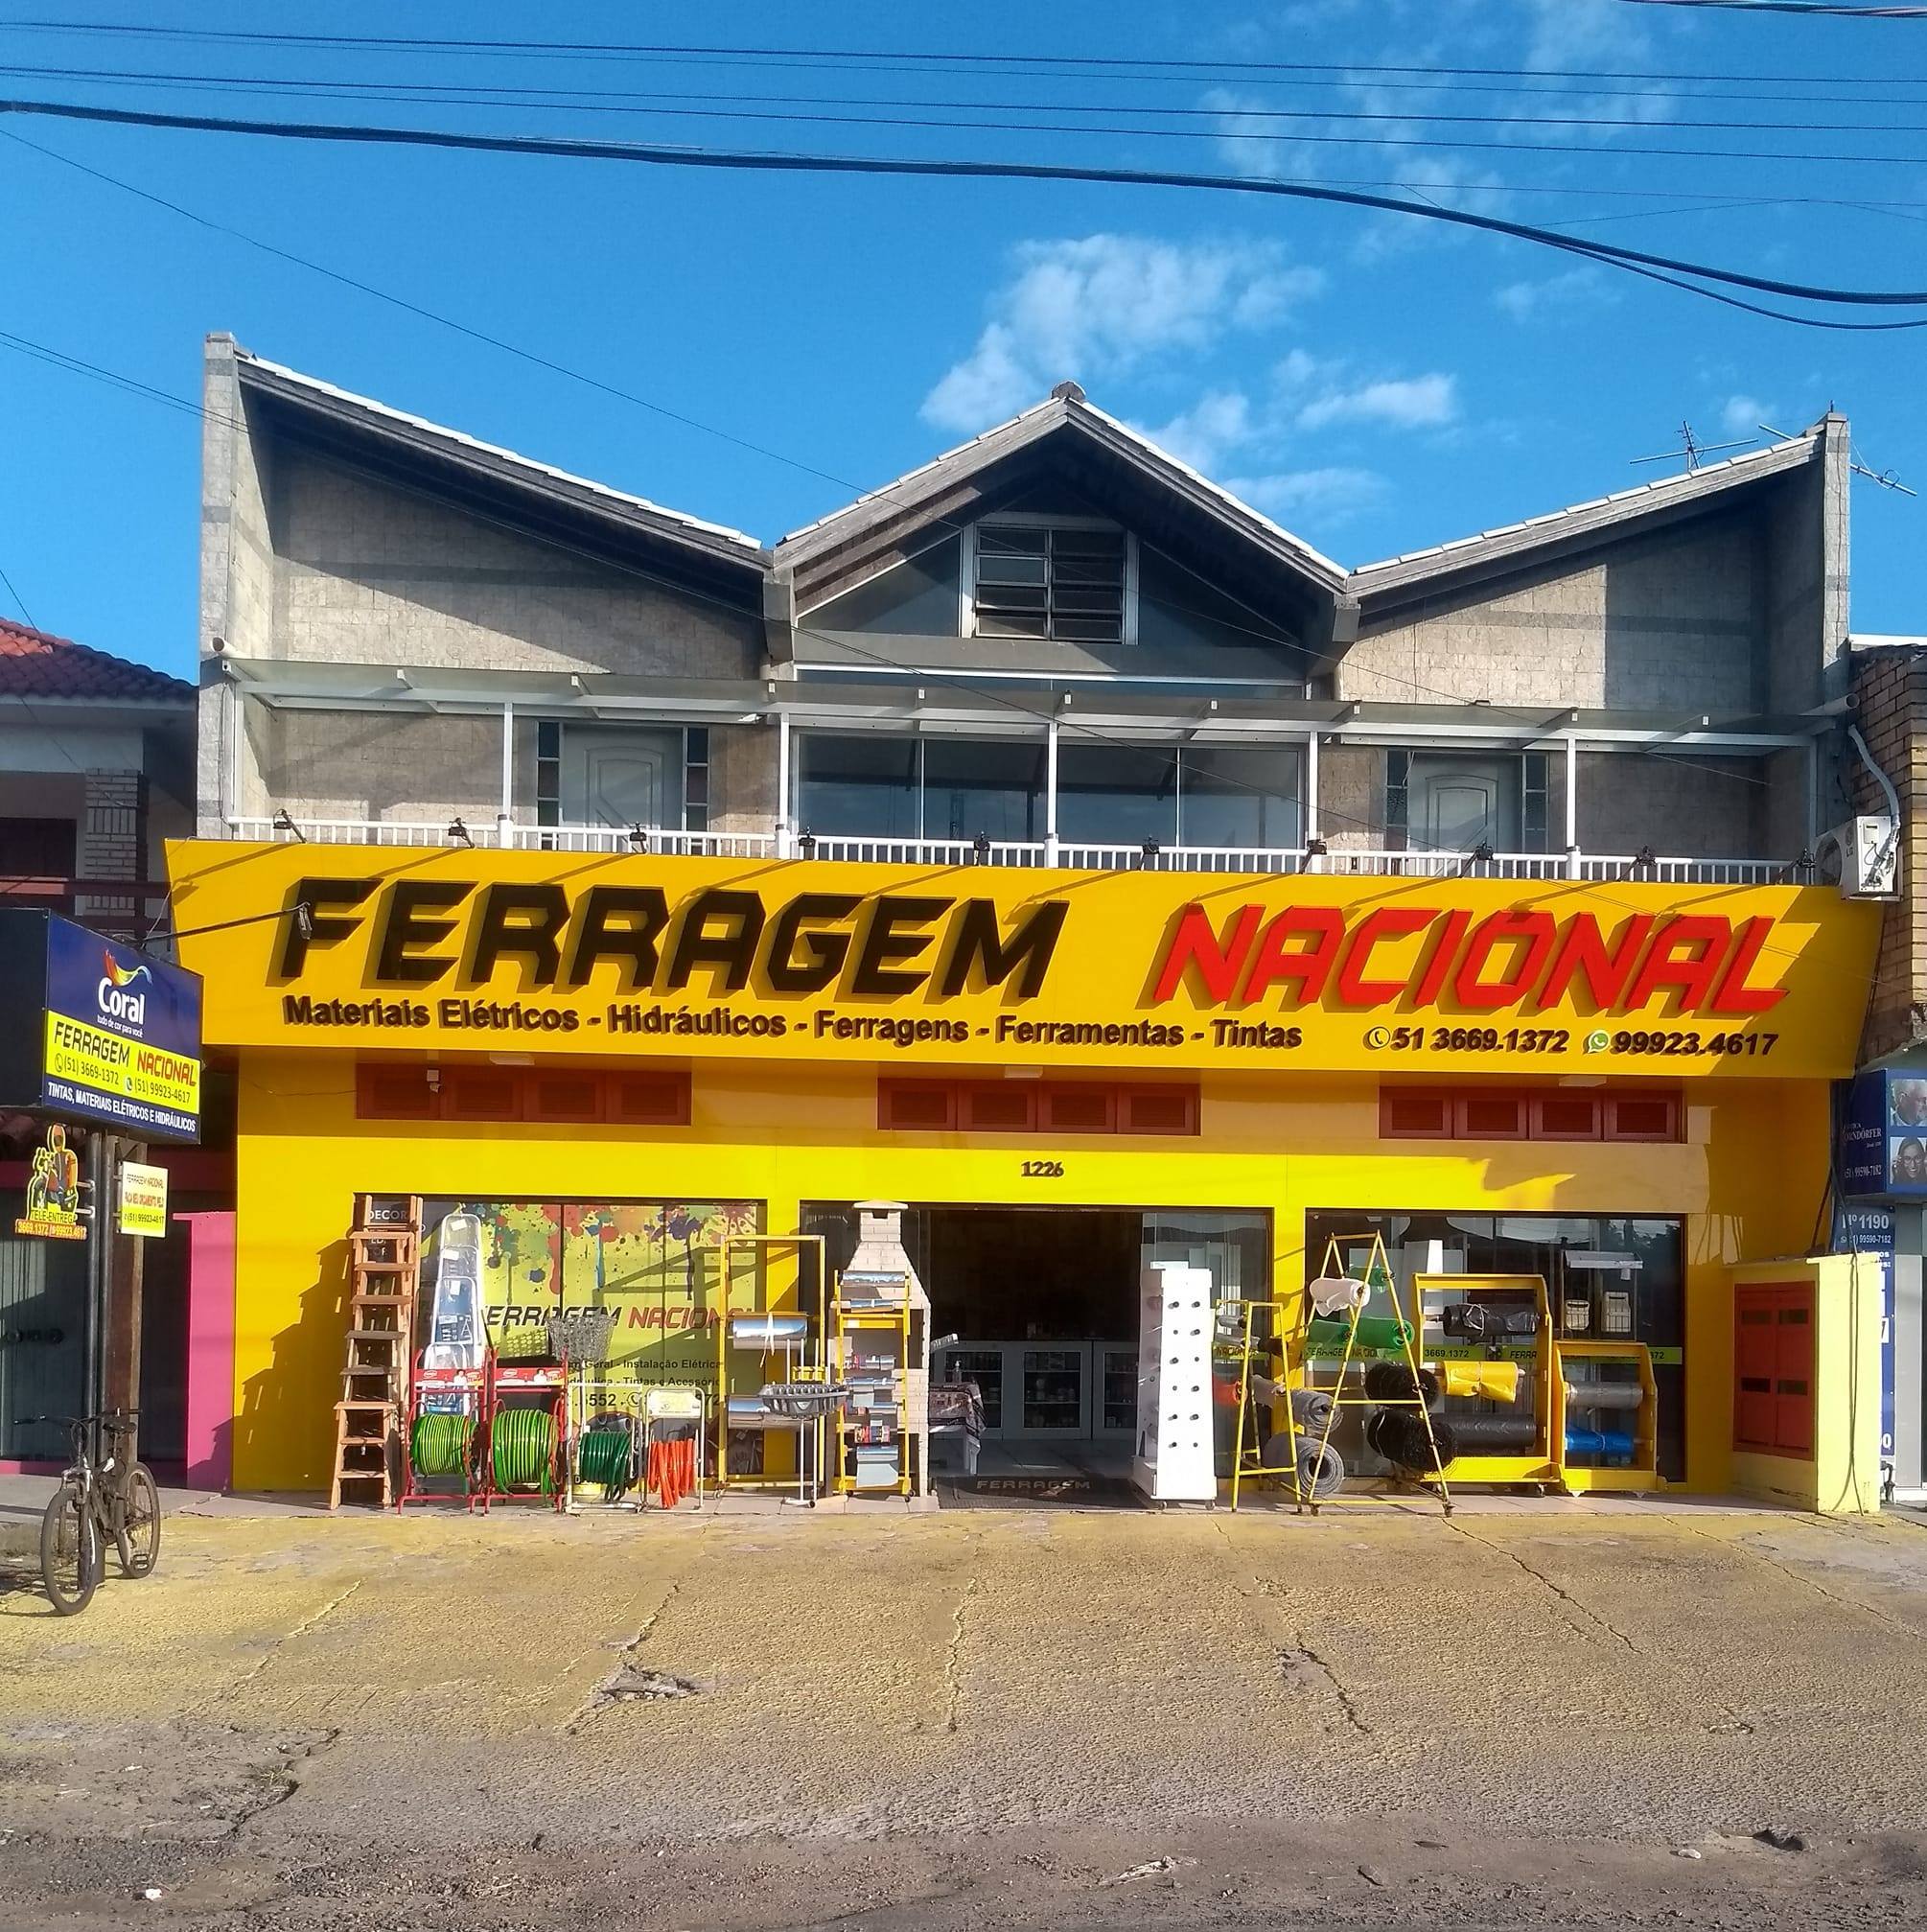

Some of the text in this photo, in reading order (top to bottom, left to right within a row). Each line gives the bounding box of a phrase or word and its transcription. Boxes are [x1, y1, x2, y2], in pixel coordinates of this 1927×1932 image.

[281, 876, 1790, 1013] FERRAGEM NACIONAL
[98, 976, 146, 1025] Coral
[283, 995, 430, 1031] Materiais
[439, 999, 580, 1032] Elétricos
[608, 1003, 786, 1036] Hidráulicos
[815, 1010, 969, 1047] Ferragens
[996, 1014, 1184, 1047] Ferramentas
[1210, 1019, 1302, 1048] Tintas
[1391, 1027, 1778, 1056] 51 3669.1372 99923.4617
[55, 1021, 197, 1086] FERRAGEM NACIONAL
[64, 1055, 120, 1085] (51) 3669-1372
[134, 1080, 191, 1104] (51) 99923-4617
[48, 1082, 197, 1132] TINTAS, MATERIAIS ELÉTRICOS E HIDRÁULICOS
[1021, 1161, 1064, 1178] 1226
[1859, 1215, 1889, 1229] 1190
[1859, 1234, 1892, 1245] 99590-7182
[486, 1306, 622, 1328] ERRAGEM
[623, 1359, 679, 1369] Instalação
[1425, 1349, 1470, 1359] 3669.1372
[1510, 1350, 1537, 1359] FERRA
[977, 1480, 1091, 1489] FERRAGEM
